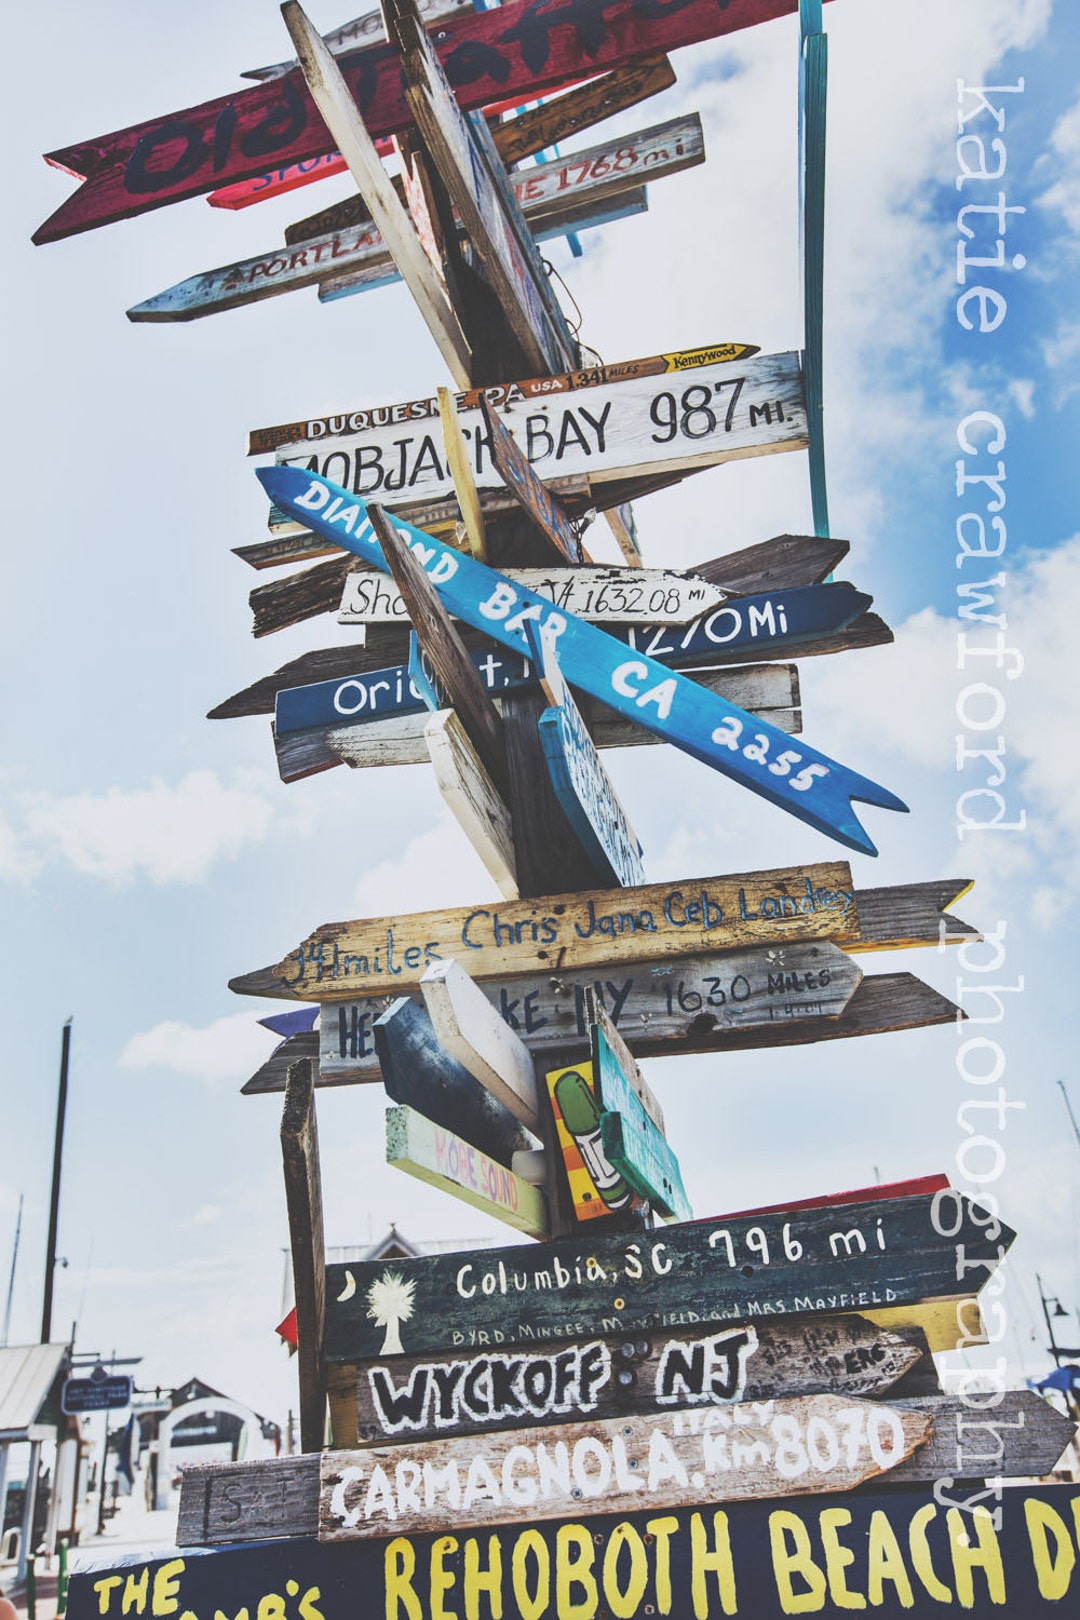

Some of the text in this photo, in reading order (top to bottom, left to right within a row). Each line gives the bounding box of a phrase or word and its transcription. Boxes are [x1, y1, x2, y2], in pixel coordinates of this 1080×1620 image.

[123, 80, 306, 194] Old
[555, 147, 638, 191] 1768
[483, 382, 527, 408] PA
[530, 377, 563, 393] USA
[608, 364, 640, 378] MILES
[673, 345, 736, 370] Kennywood
[525, 401, 612, 463] BAY
[649, 377, 746, 443] 987
[611, 660, 677, 719] CA
[711, 716, 830, 791] 2255
[461, 909, 558, 949] Chris
[574, 900, 657, 939] Jana
[664, 890, 723, 930] Ceb
[738, 877, 854, 921] Landrey
[663, 974, 752, 1016] 1630
[767, 969, 832, 995] MILES
[480, 1155, 518, 1212] SOUND
[708, 1222, 804, 1267] 796
[829, 1217, 886, 1257] mi
[794, 1288, 897, 1311] MAYFIELD
[366, 1339, 612, 1435] WYCKOFF
[655, 1324, 759, 1406] NJ
[771, 1407, 905, 1478] 8070
[93, 1558, 186, 1616] THE
[384, 1510, 738, 1620] REHOBOTH
[768, 1502, 1006, 1615] BEACH
